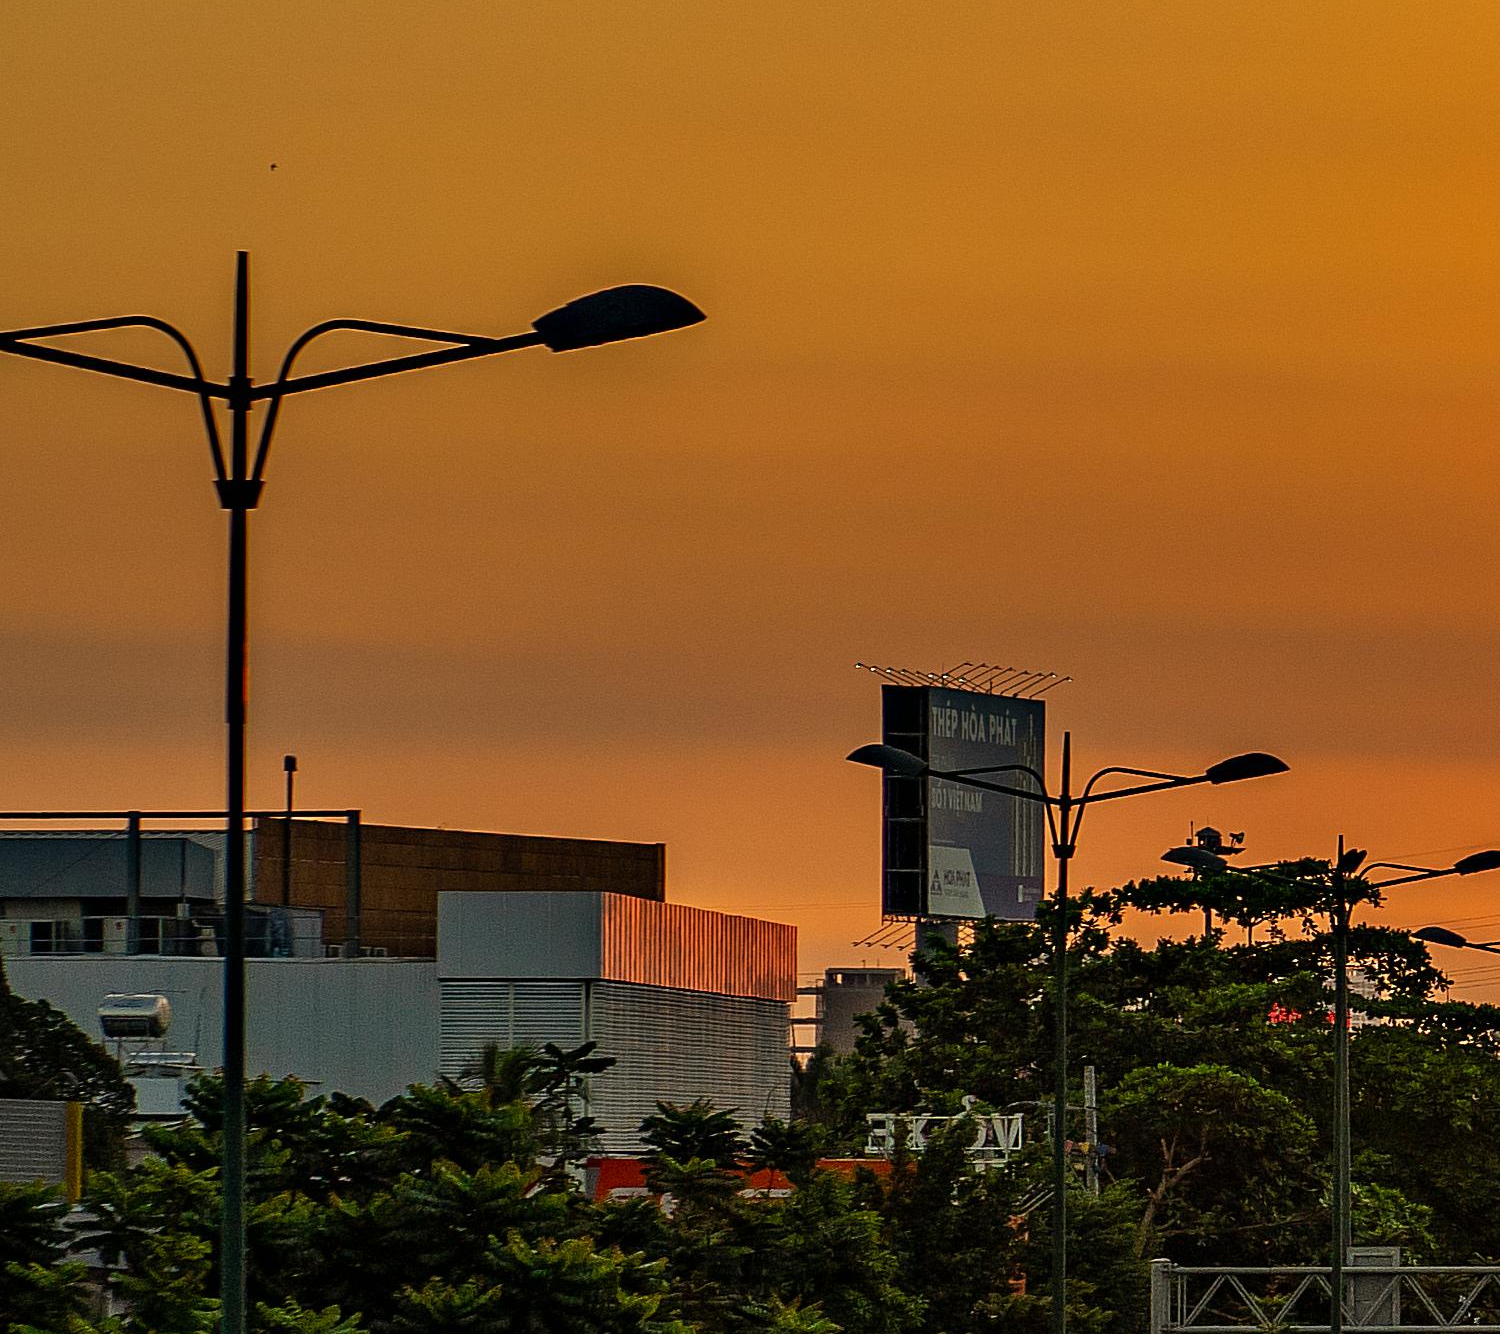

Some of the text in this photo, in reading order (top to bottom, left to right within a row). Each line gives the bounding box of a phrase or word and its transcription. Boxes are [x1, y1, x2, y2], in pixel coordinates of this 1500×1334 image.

[932, 700, 1018, 746] THÉP HÒA PHÁT
